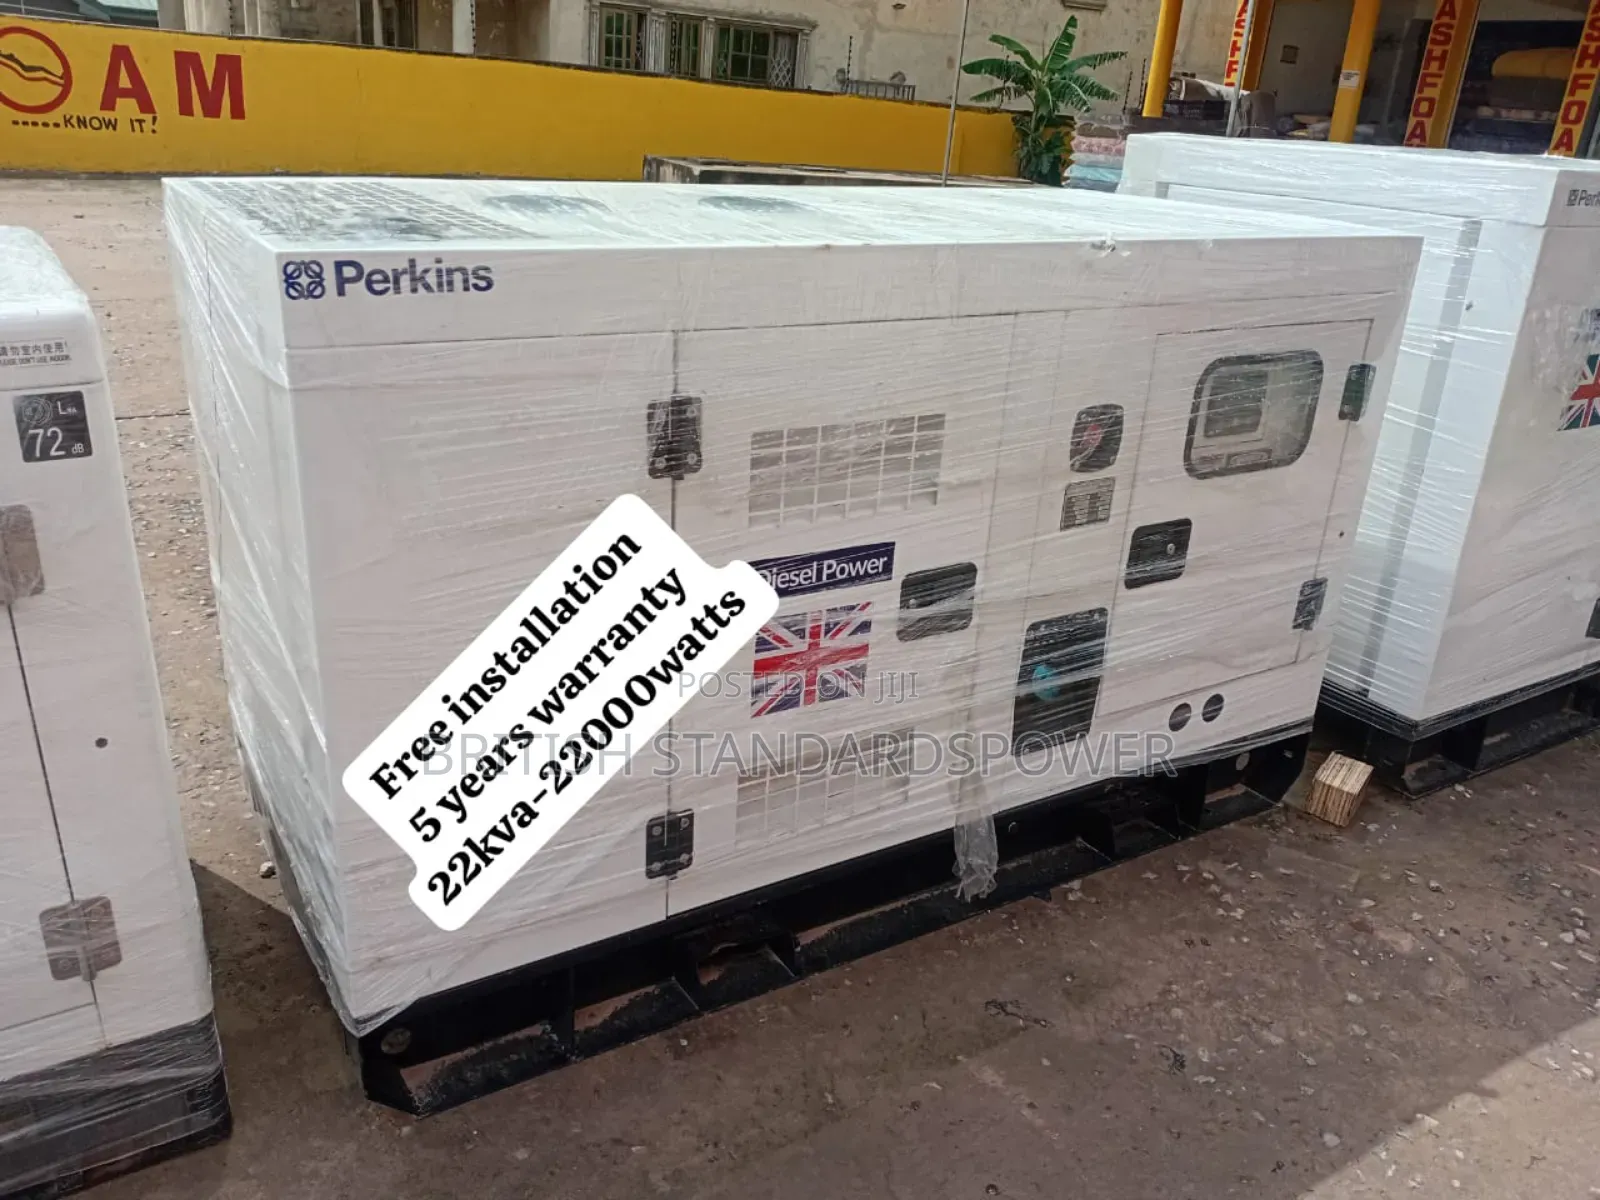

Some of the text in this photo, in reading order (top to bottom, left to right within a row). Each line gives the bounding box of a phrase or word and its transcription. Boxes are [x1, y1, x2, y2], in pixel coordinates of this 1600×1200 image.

[1405, 0, 1457, 148] ASHFOA
[130, 115, 158, 134] IT!
[333, 257, 495, 297] Perkins
[28, 427, 67, 458] 72
[71, 443, 85, 454] dB
[822, 557, 888, 582] Power
